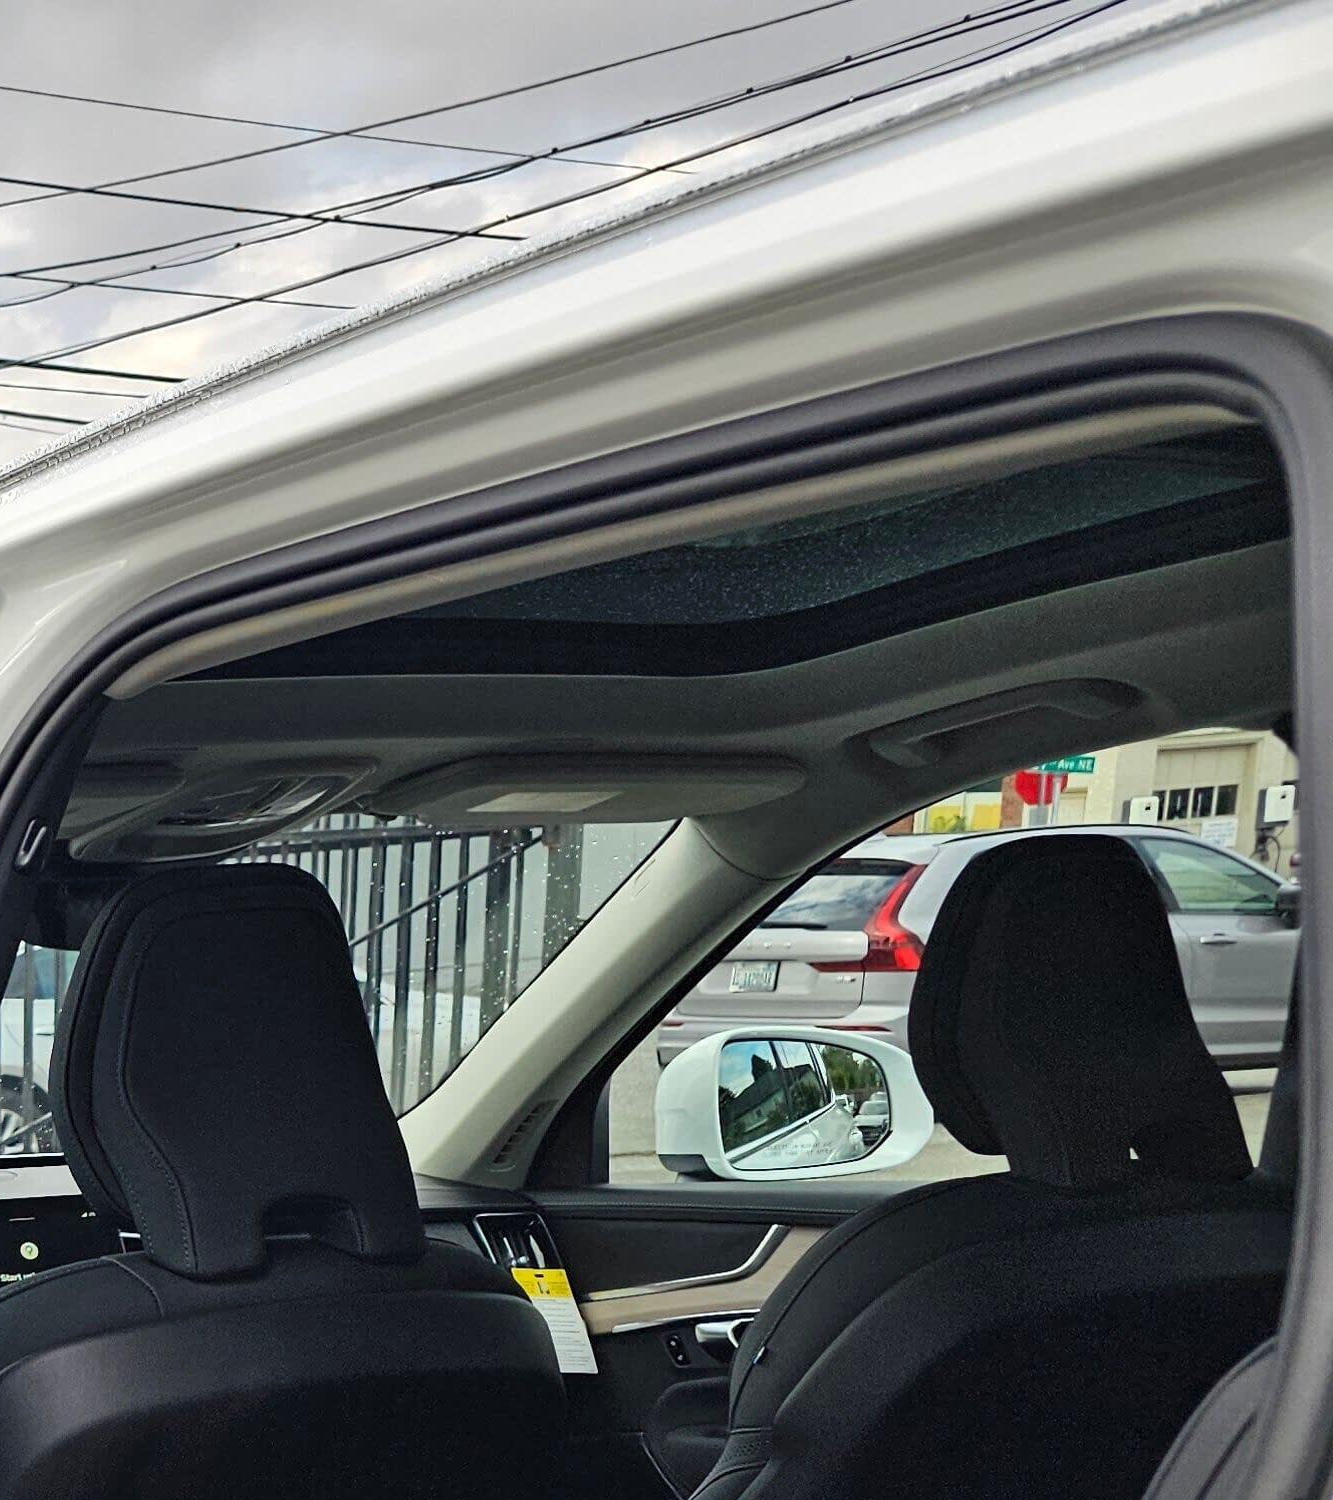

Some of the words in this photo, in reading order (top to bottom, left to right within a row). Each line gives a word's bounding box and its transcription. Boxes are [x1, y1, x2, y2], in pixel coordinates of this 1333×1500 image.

[1057, 759, 1075, 770] Ave
[1078, 759, 1094, 770] NE
[0, 1273, 23, 1282] Start
